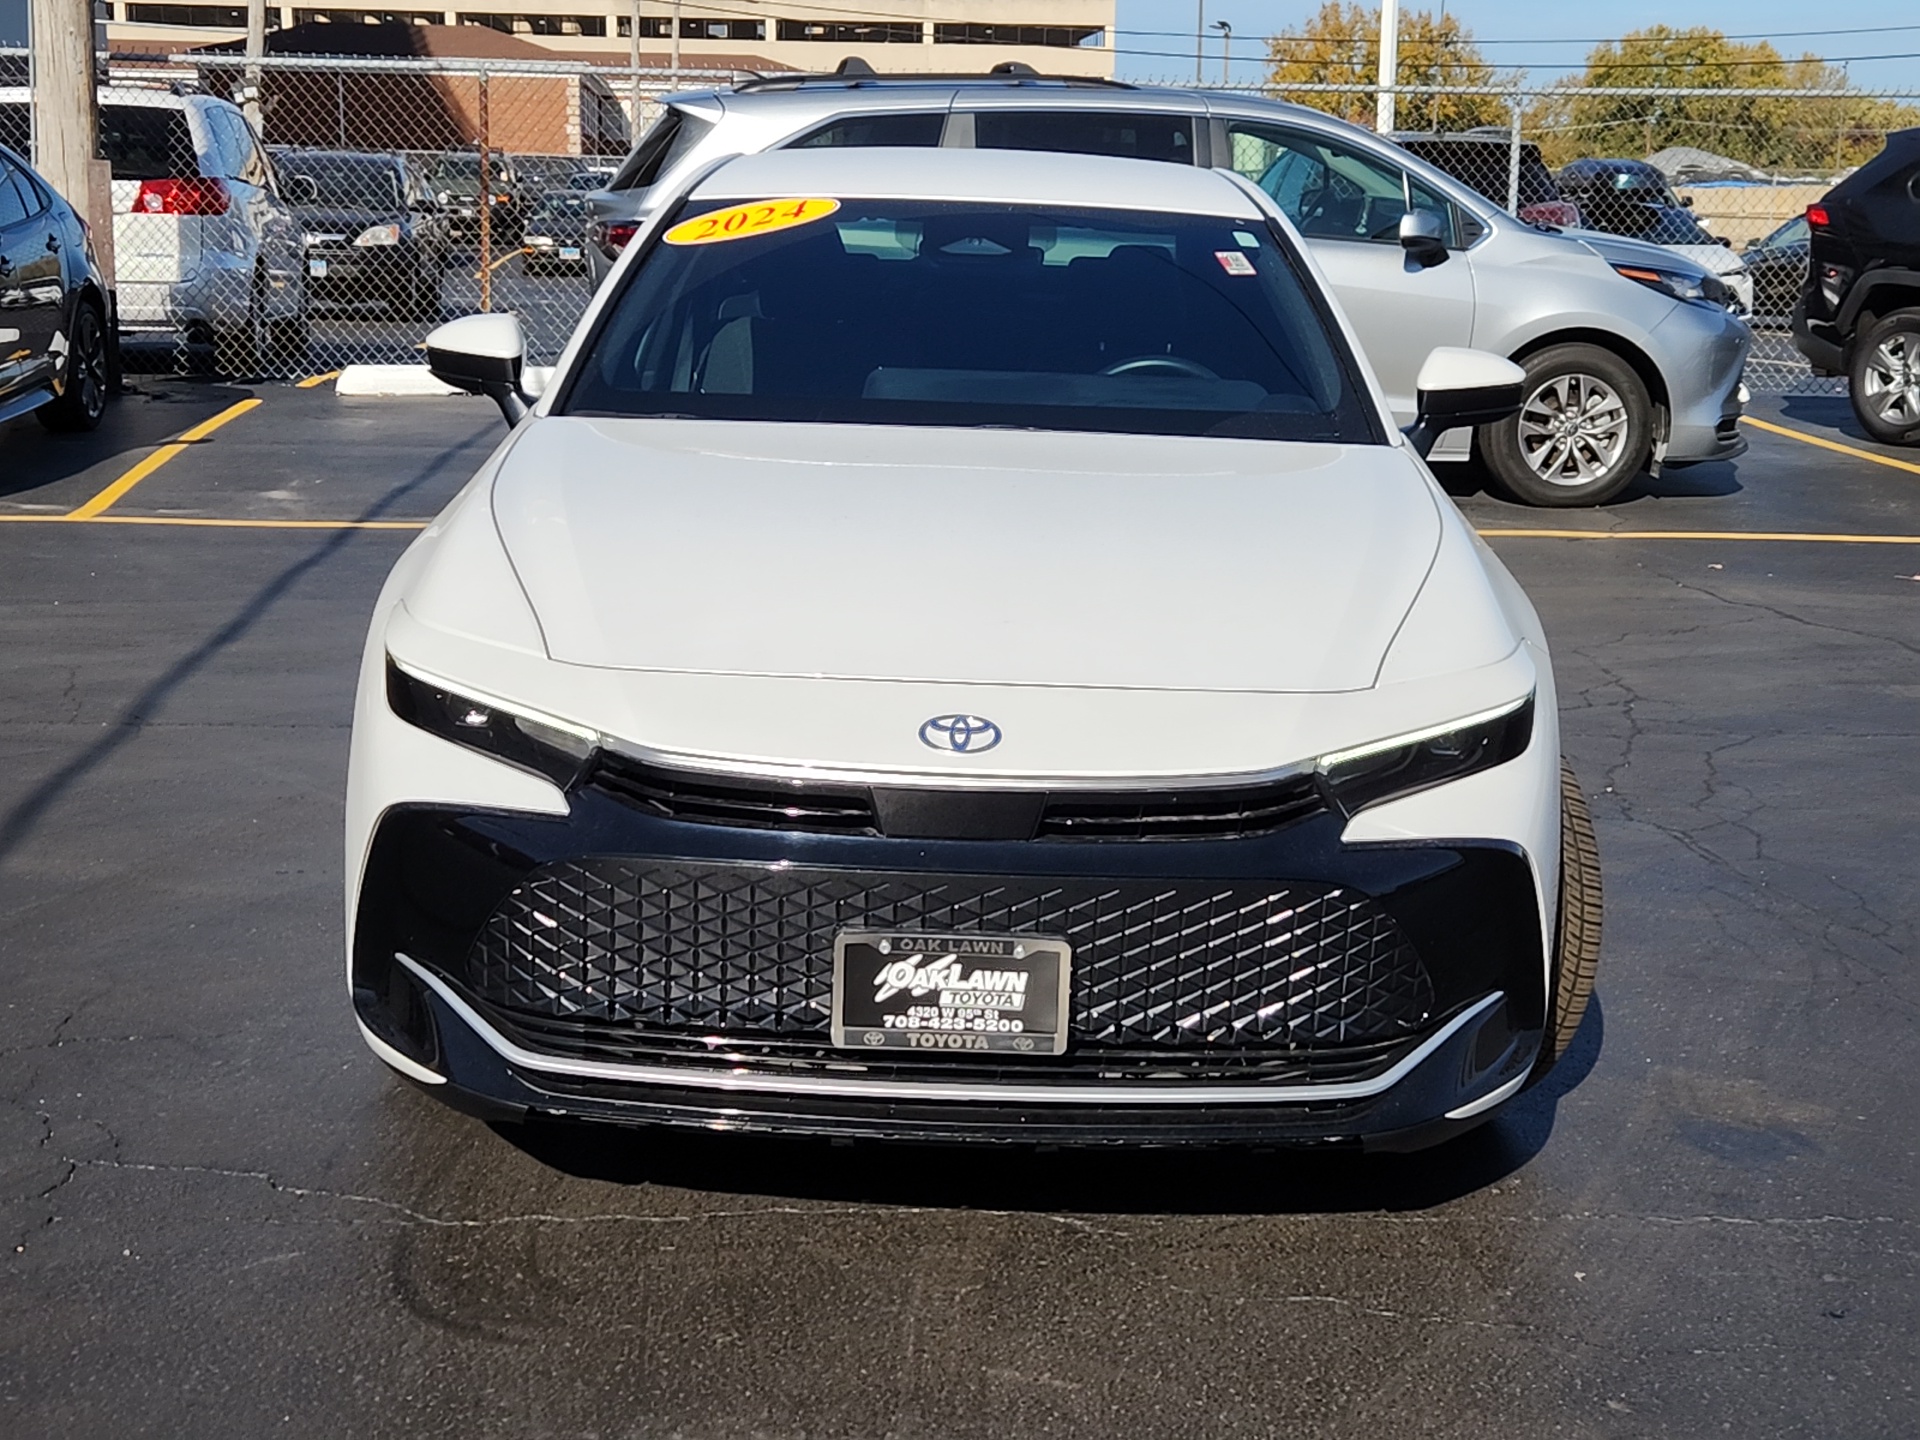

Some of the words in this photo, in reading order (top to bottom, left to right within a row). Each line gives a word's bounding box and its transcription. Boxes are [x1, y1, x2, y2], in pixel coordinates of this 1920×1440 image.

[694, 200, 808, 240] 2024
[900, 938, 942, 952] OAK
[949, 939, 1004, 955] LAWN
[949, 991, 1014, 1006] TOYOTA
[906, 1006, 939, 1018] 4320
[941, 1007, 955, 1018] W
[984, 1009, 999, 1020] St
[883, 1015, 1024, 1032] 708-423-5200
[907, 1033, 989, 1049] TOYOTA
